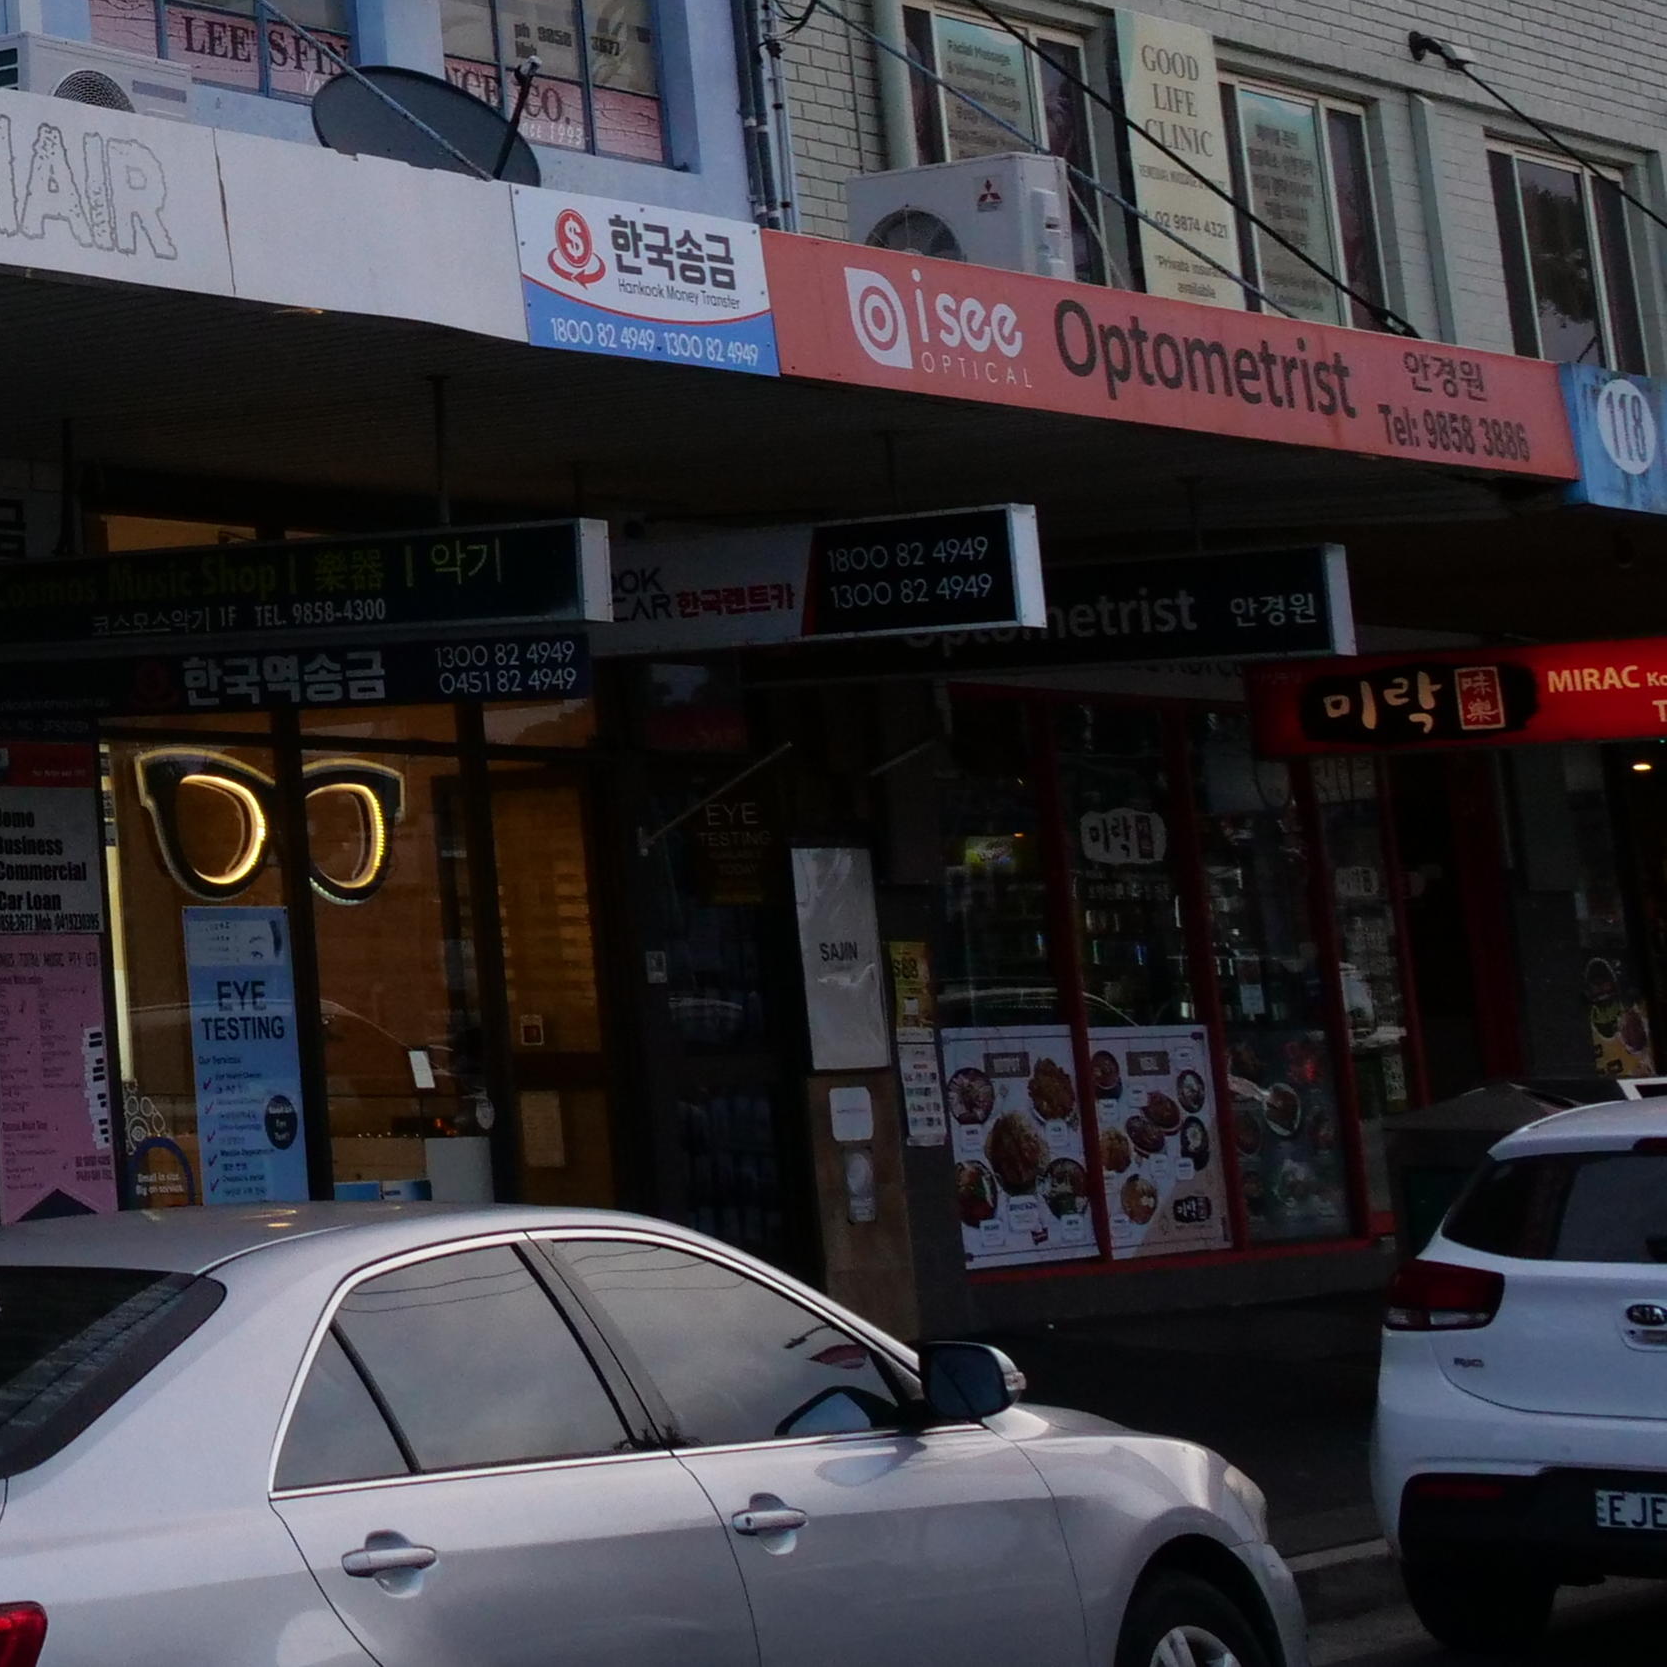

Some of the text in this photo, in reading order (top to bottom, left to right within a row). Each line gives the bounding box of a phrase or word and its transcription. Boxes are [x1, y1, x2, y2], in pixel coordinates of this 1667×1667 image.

[1142, 45, 1199, 81] GOOD
[1154, 83, 1197, 117] LIFE
[1146, 119, 1213, 157] CLINIC
[608, 214, 736, 290] 한국송금
[619, 279, 699, 306] Hankook Money
[551, 318, 655, 352] 1800 82 4949
[664, 332, 759, 366] 1300 82 4949
[922, 352, 1032, 388] OPTICAL
[1055, 299, 1357, 419] Optometrist
[1403, 351, 1488, 402] 안경원
[1379, 404, 1418, 446] Tel:
[1606, 390, 1648, 463] 118
[430, 537, 502, 584] 악기
[827, 537, 988, 573] 1800 82 4949
[203, 552, 276, 601] Shop
[830, 573, 993, 609] 1300 82 4949
[292, 598, 385, 624] 9858-4300
[1229, 592, 1317, 628] 안경원
[435, 640, 575, 669] 1300 82 4949
[439, 668, 576, 694] 0451 82 4949
[1547, 665, 1640, 693] MIRAC
[705, 802, 761, 826] EYE
[699, 830, 771, 847] TESTING
[27, 891, 61, 910] Loan
[217, 980, 266, 1012] EYE
[201, 1016, 284, 1041] TESTING
